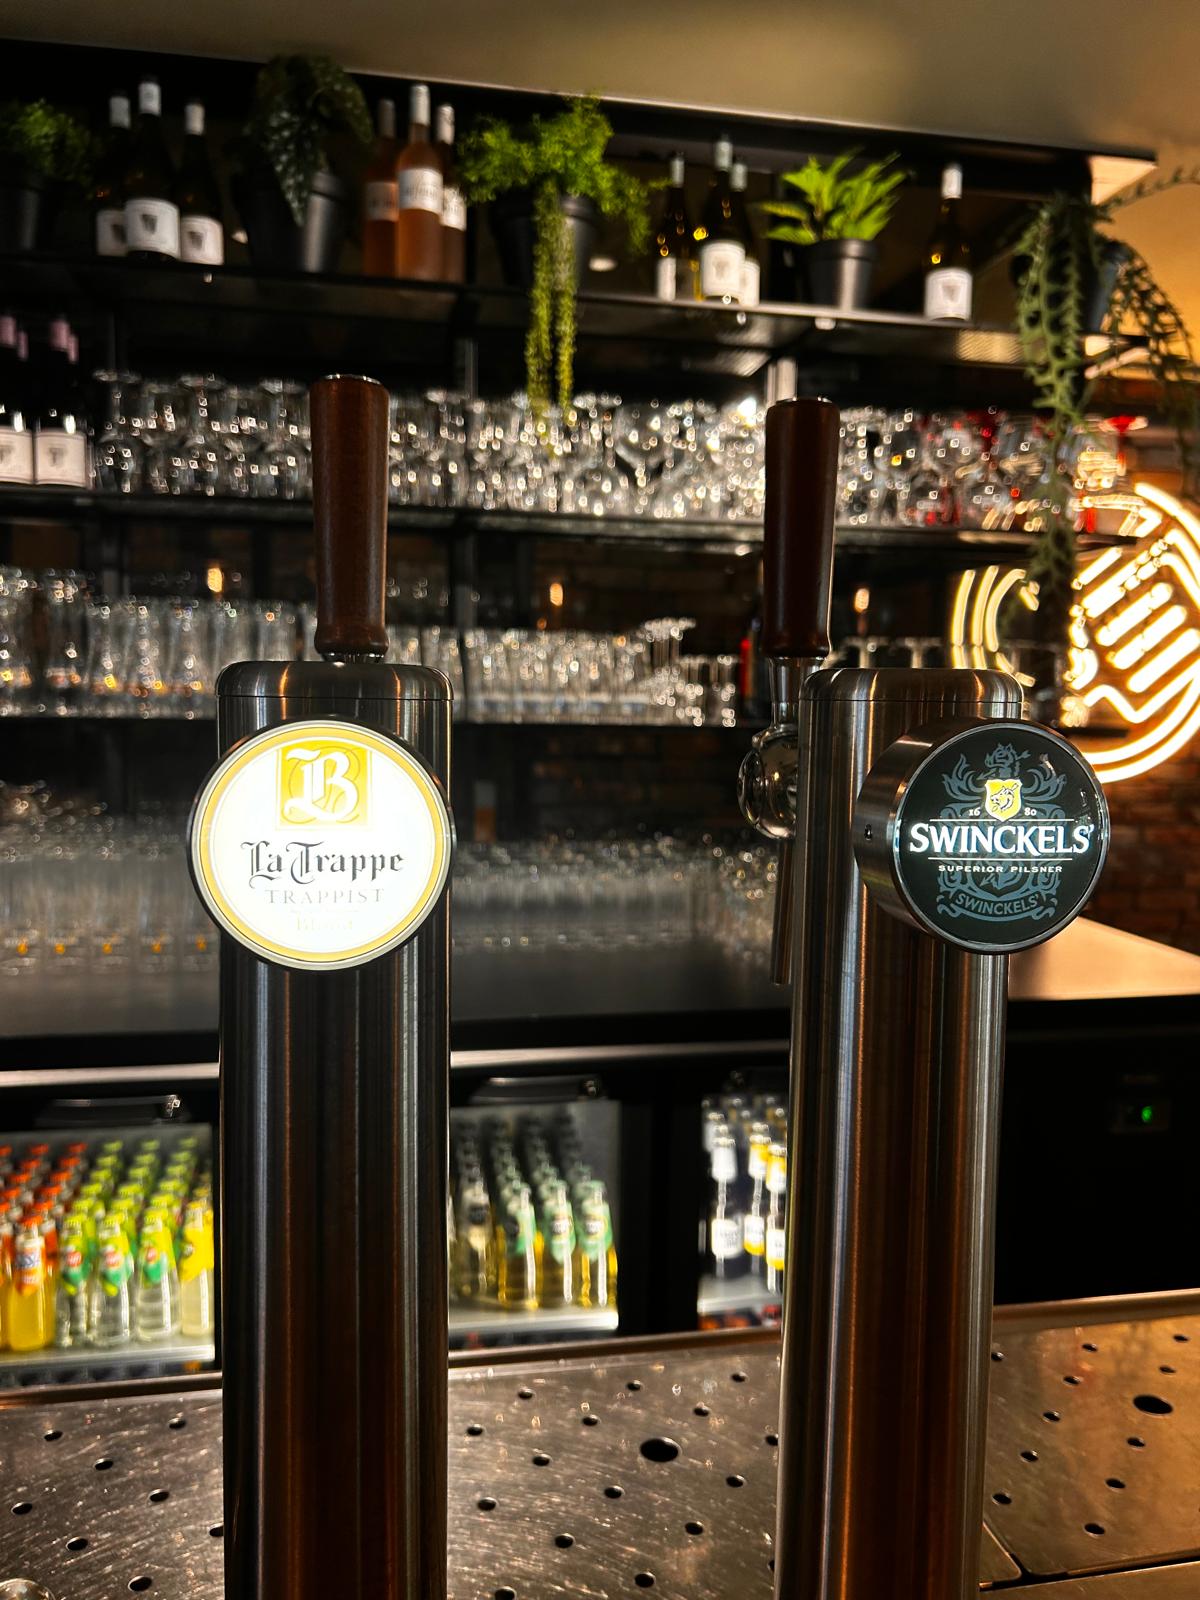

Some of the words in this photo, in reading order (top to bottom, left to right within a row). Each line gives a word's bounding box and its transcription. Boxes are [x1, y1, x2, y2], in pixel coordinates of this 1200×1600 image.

[969, 808, 981, 816] 16
[240, 840, 283, 889] La
[286, 841, 404, 885] Trappe
[938, 864, 1004, 874] SUPERIOR
[1010, 865, 1063, 874] PILSNER
[264, 888, 385, 905] TRAPPIST
